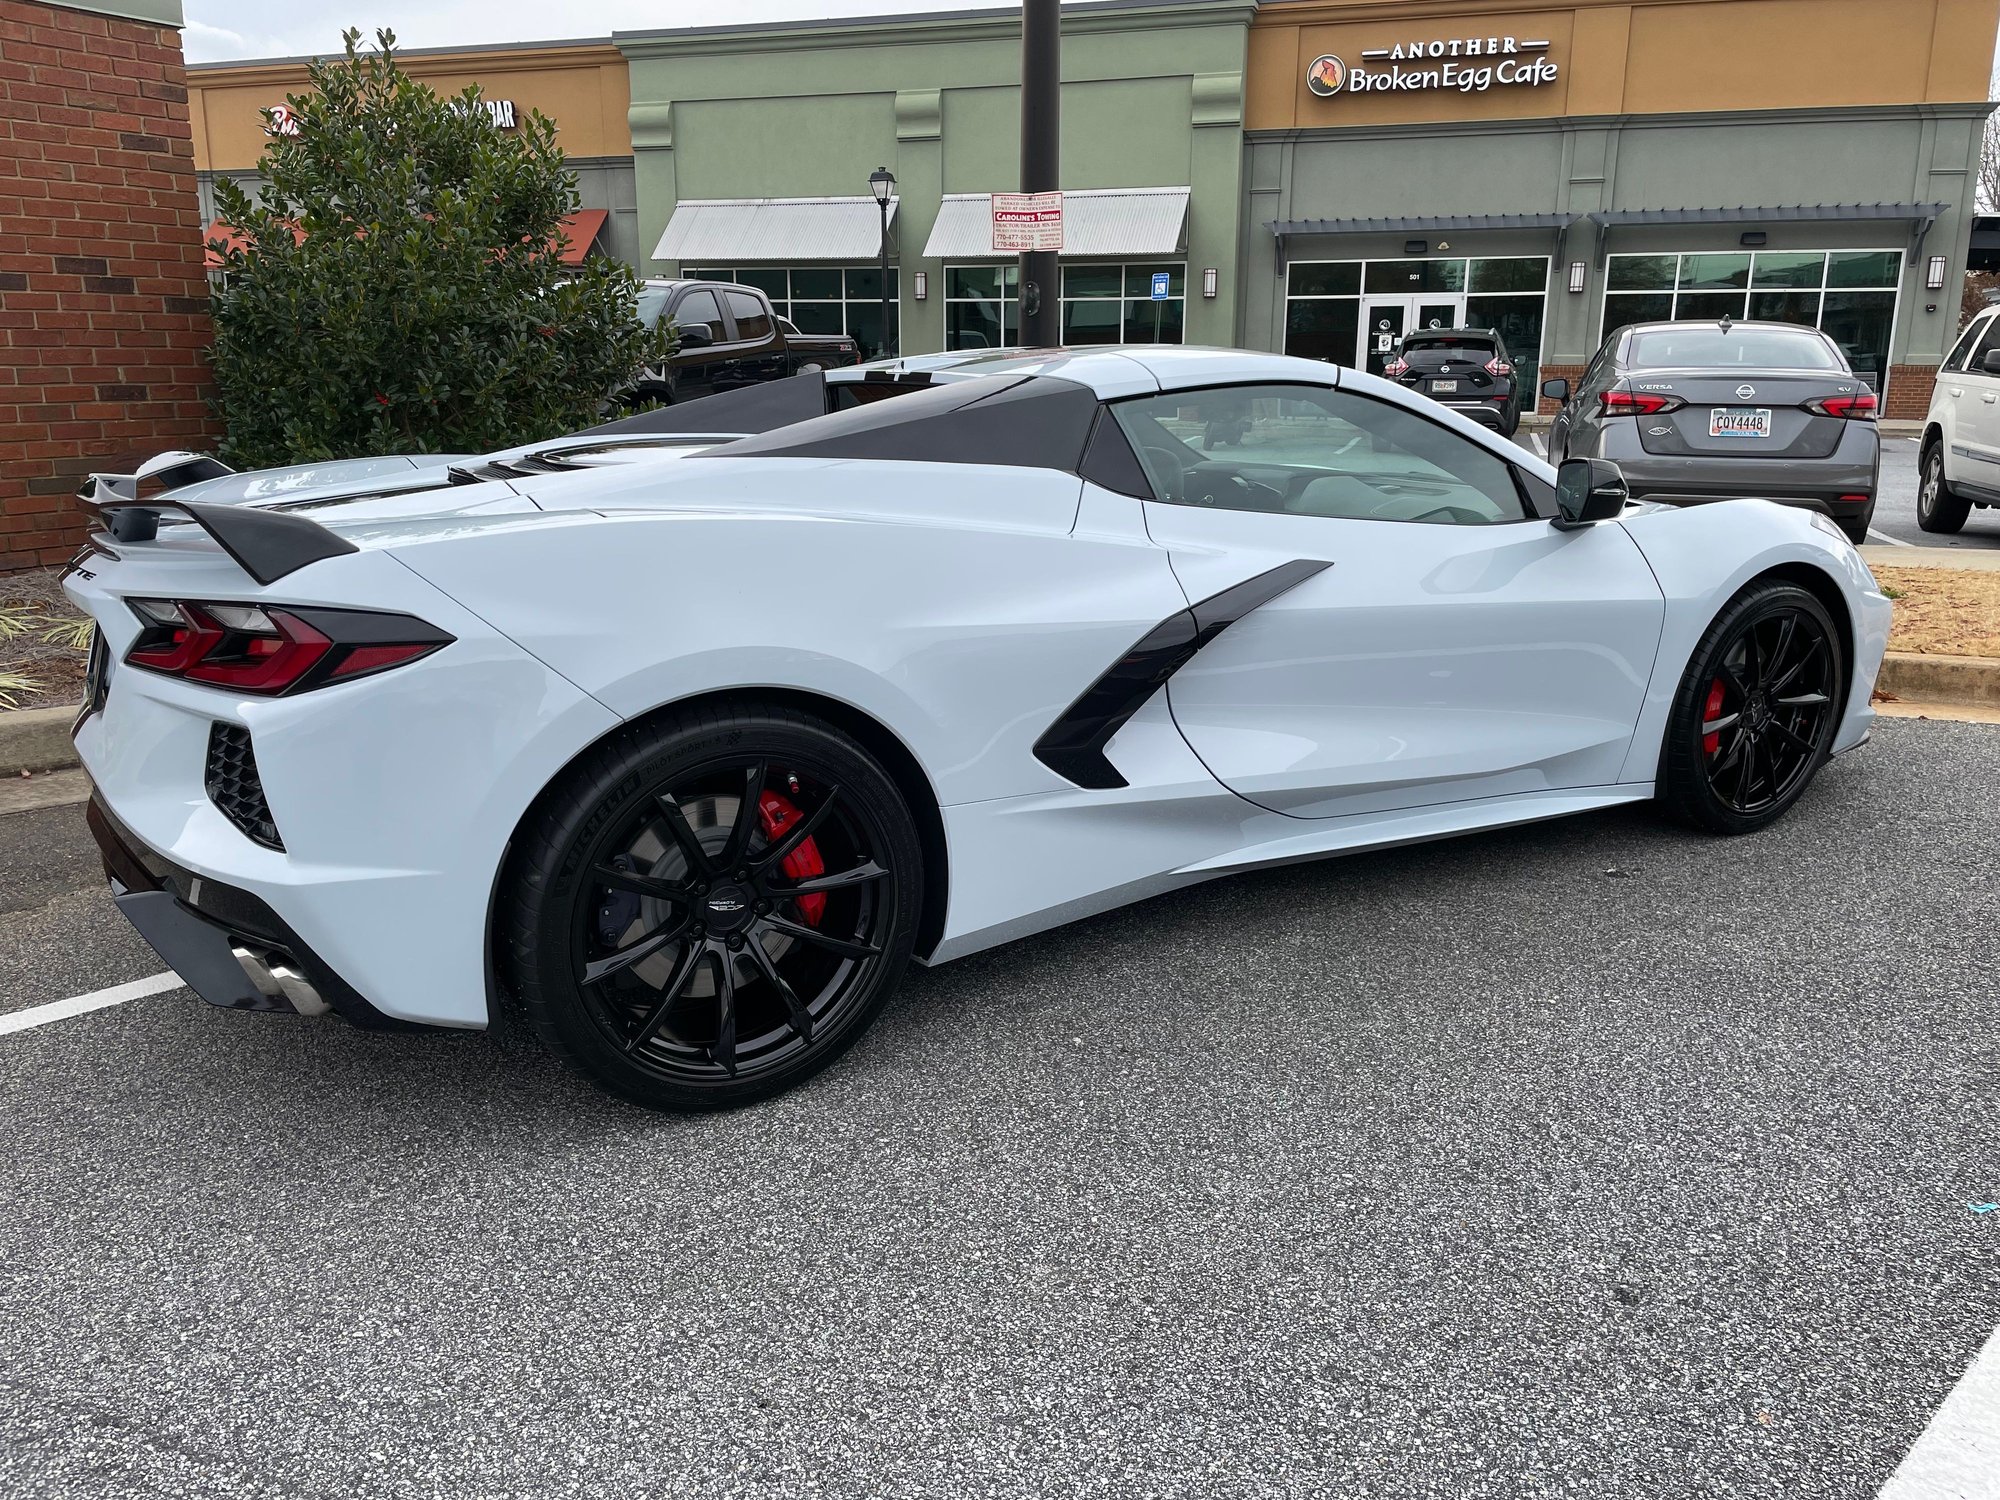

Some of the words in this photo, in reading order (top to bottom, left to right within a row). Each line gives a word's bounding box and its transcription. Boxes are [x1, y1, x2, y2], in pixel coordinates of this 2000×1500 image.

[1389, 36, 1518, 60] ANOTHER
[1349, 65, 1439, 92] Broken
[1441, 62, 1492, 92] Egg
[1495, 56, 1558, 86] Cafe
